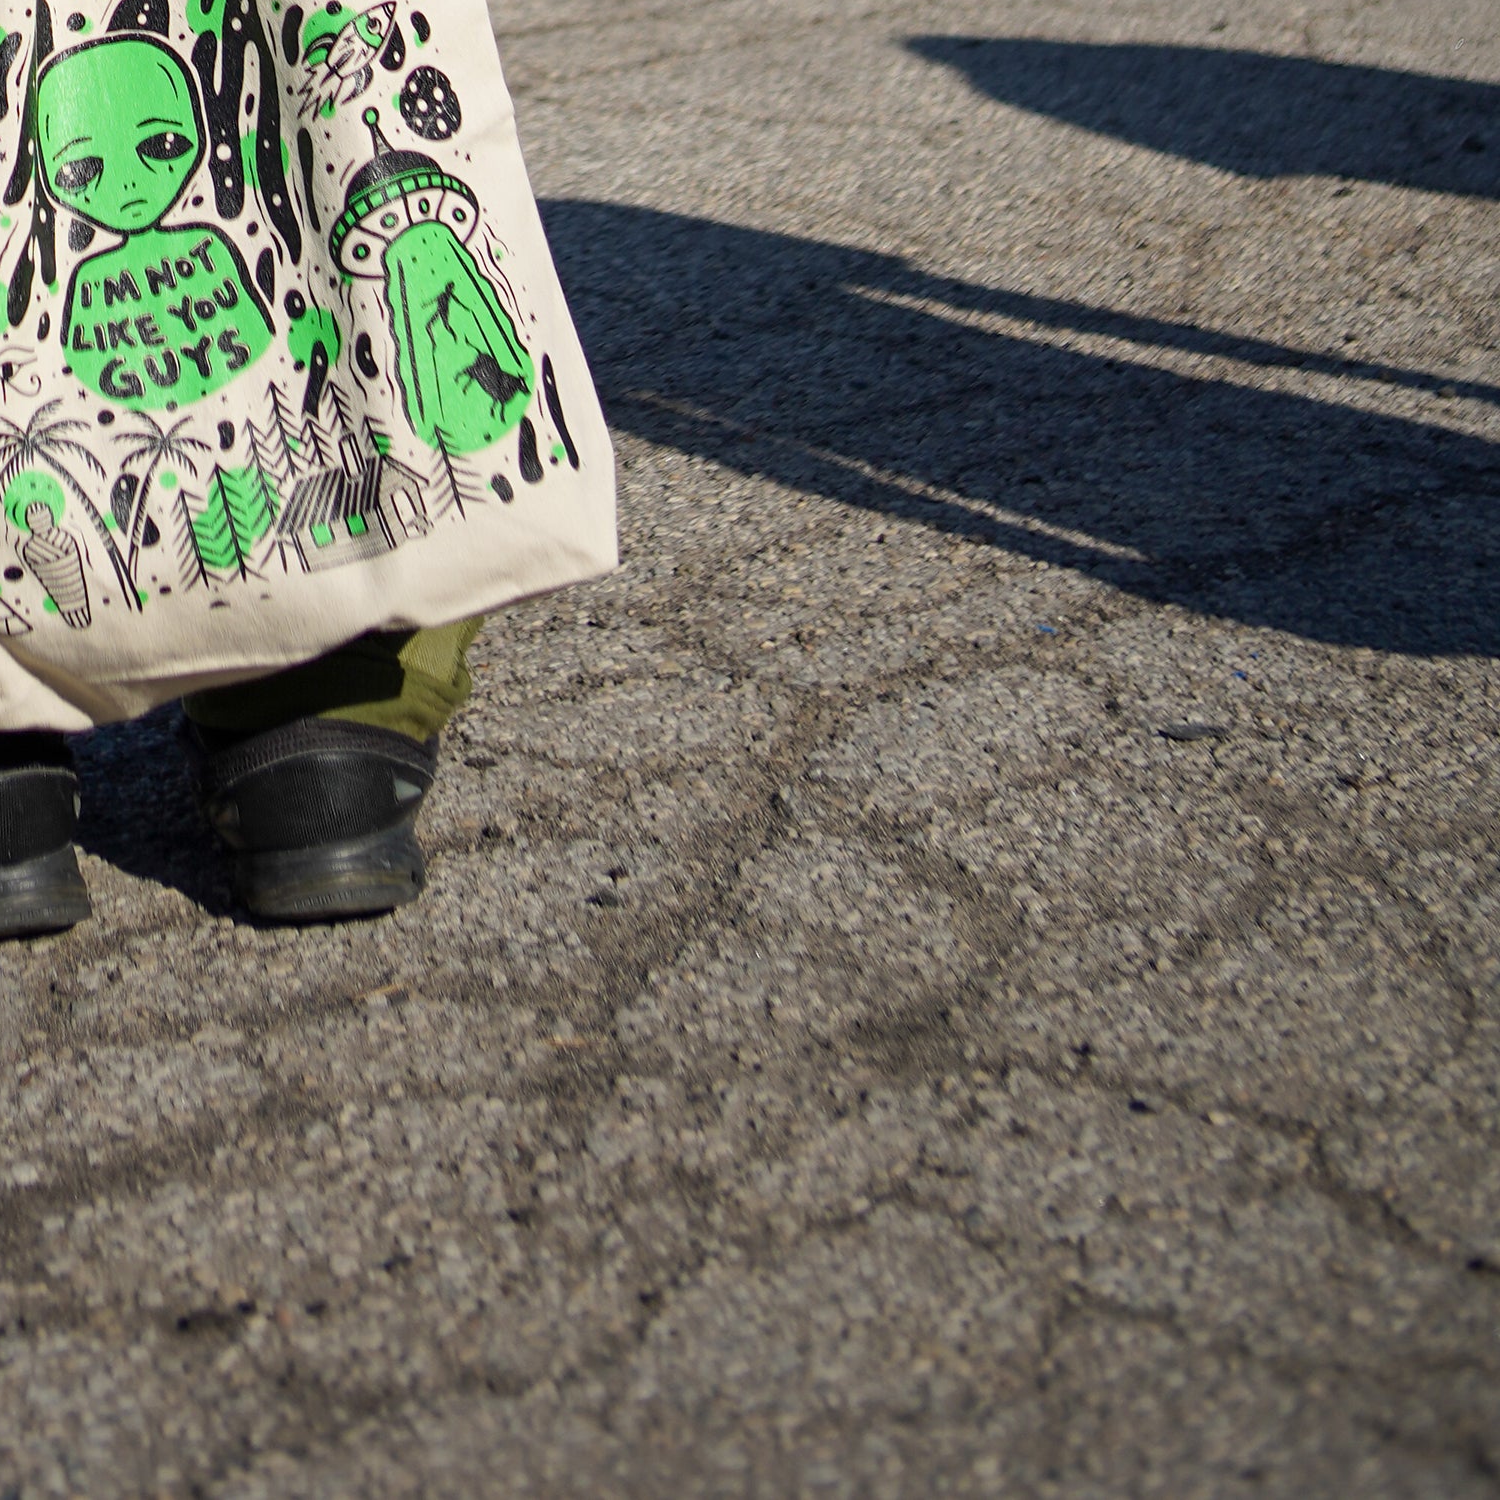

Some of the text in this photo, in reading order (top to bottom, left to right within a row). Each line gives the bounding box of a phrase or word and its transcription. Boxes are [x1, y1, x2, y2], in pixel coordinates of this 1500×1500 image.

[81, 236, 216, 308] I'M NOT
[72, 278, 239, 352] LIKE YOU
[99, 327, 251, 399] GUYS
